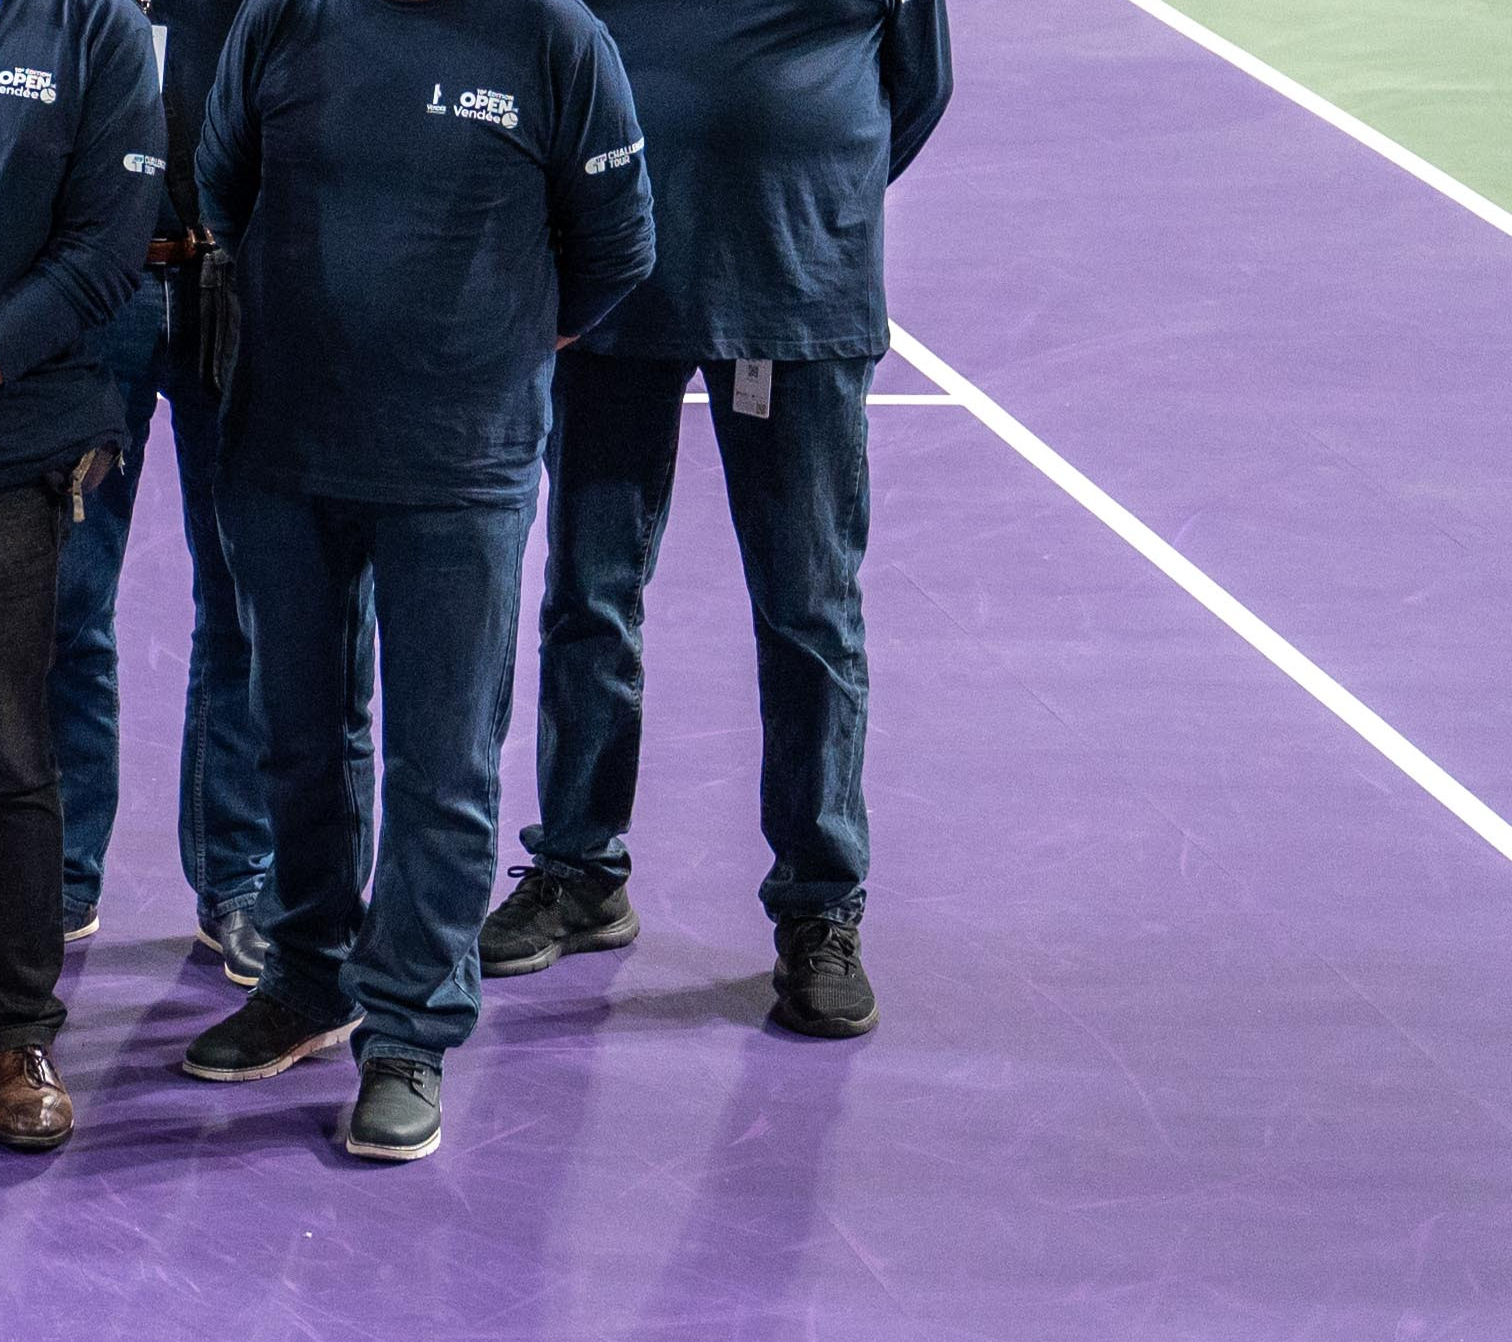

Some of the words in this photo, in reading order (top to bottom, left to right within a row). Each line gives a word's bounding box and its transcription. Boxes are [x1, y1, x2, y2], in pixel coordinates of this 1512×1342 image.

[460, 92, 513, 114] OPEN
[453, 105, 500, 124] Vendée
[609, 155, 630, 168] TOUR
